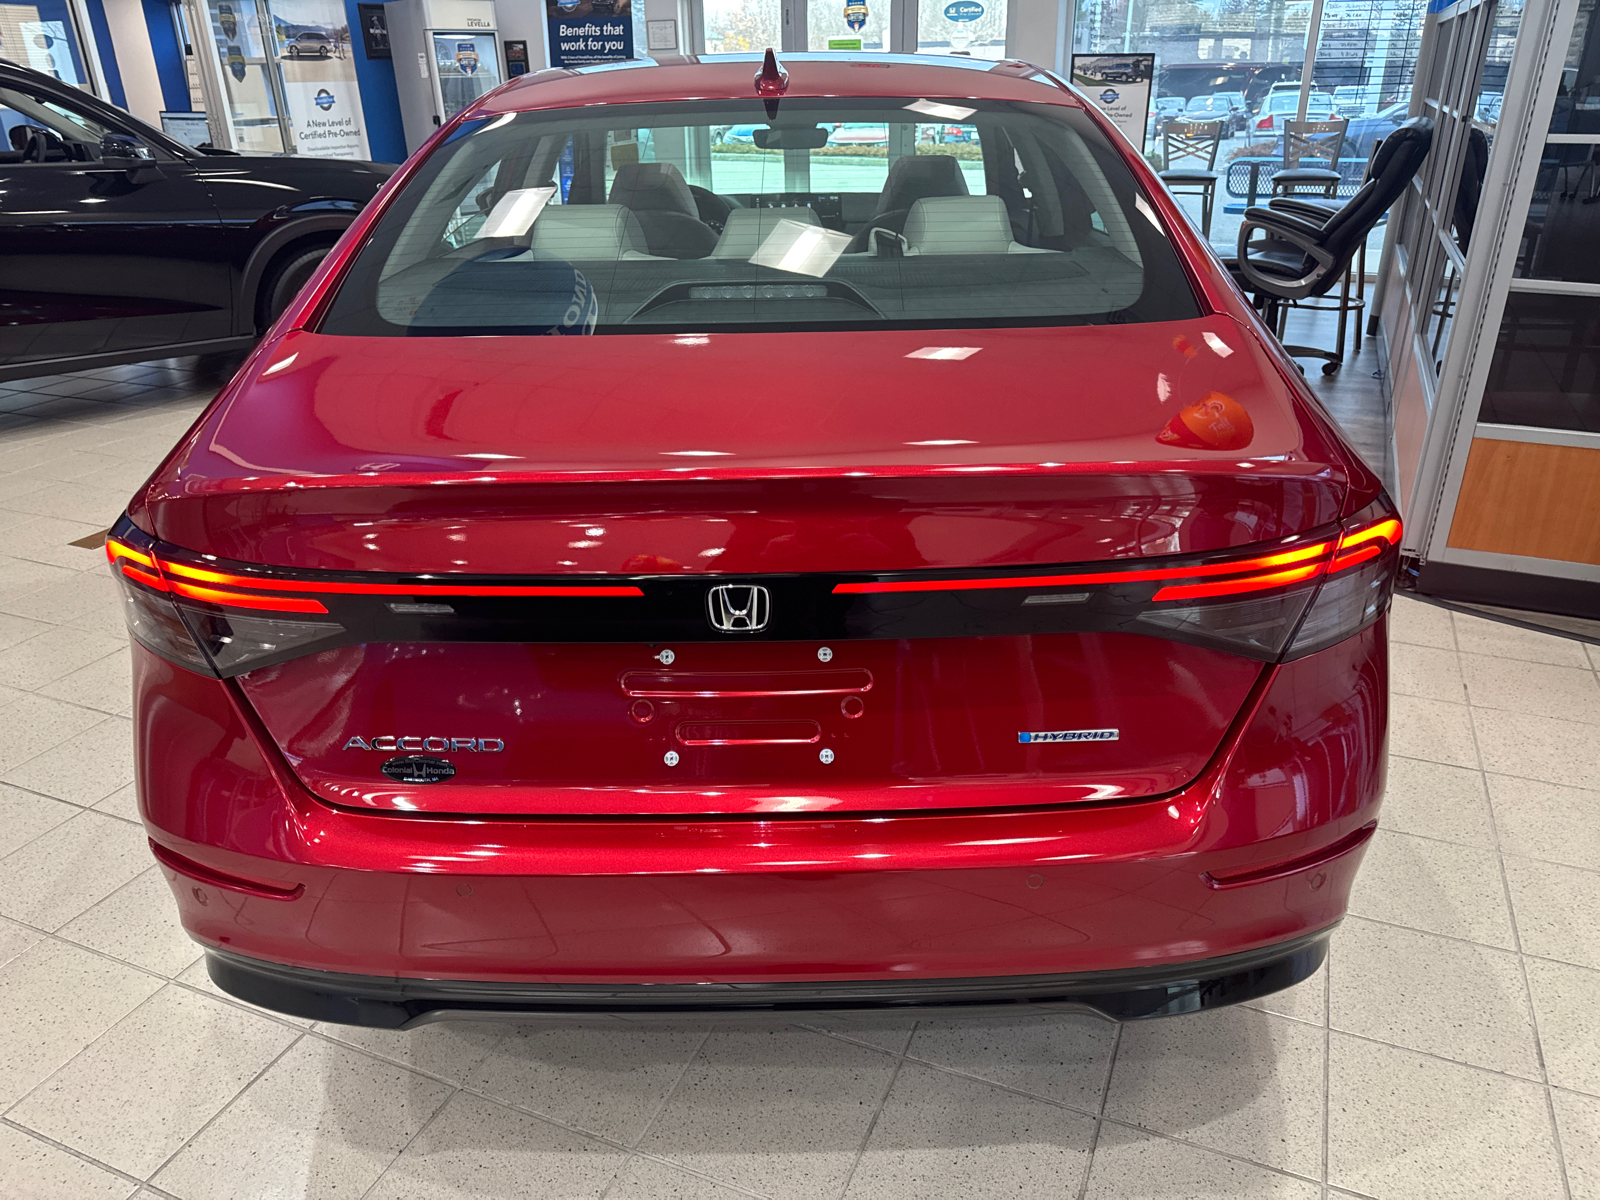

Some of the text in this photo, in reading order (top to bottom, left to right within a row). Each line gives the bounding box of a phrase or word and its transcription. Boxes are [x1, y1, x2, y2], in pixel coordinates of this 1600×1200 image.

[559, 22, 624, 36] Benefits that
[560, 38, 624, 53] work for you
[312, 120, 327, 128] New
[327, 118, 344, 128] Level
[345, 117, 352, 126] of
[299, 128, 361, 140] Certified Pre-Owned
[1032, 731, 1115, 742] HYBRID
[342, 735, 505, 752] ACCORD
[426, 767, 455, 775] Honda
